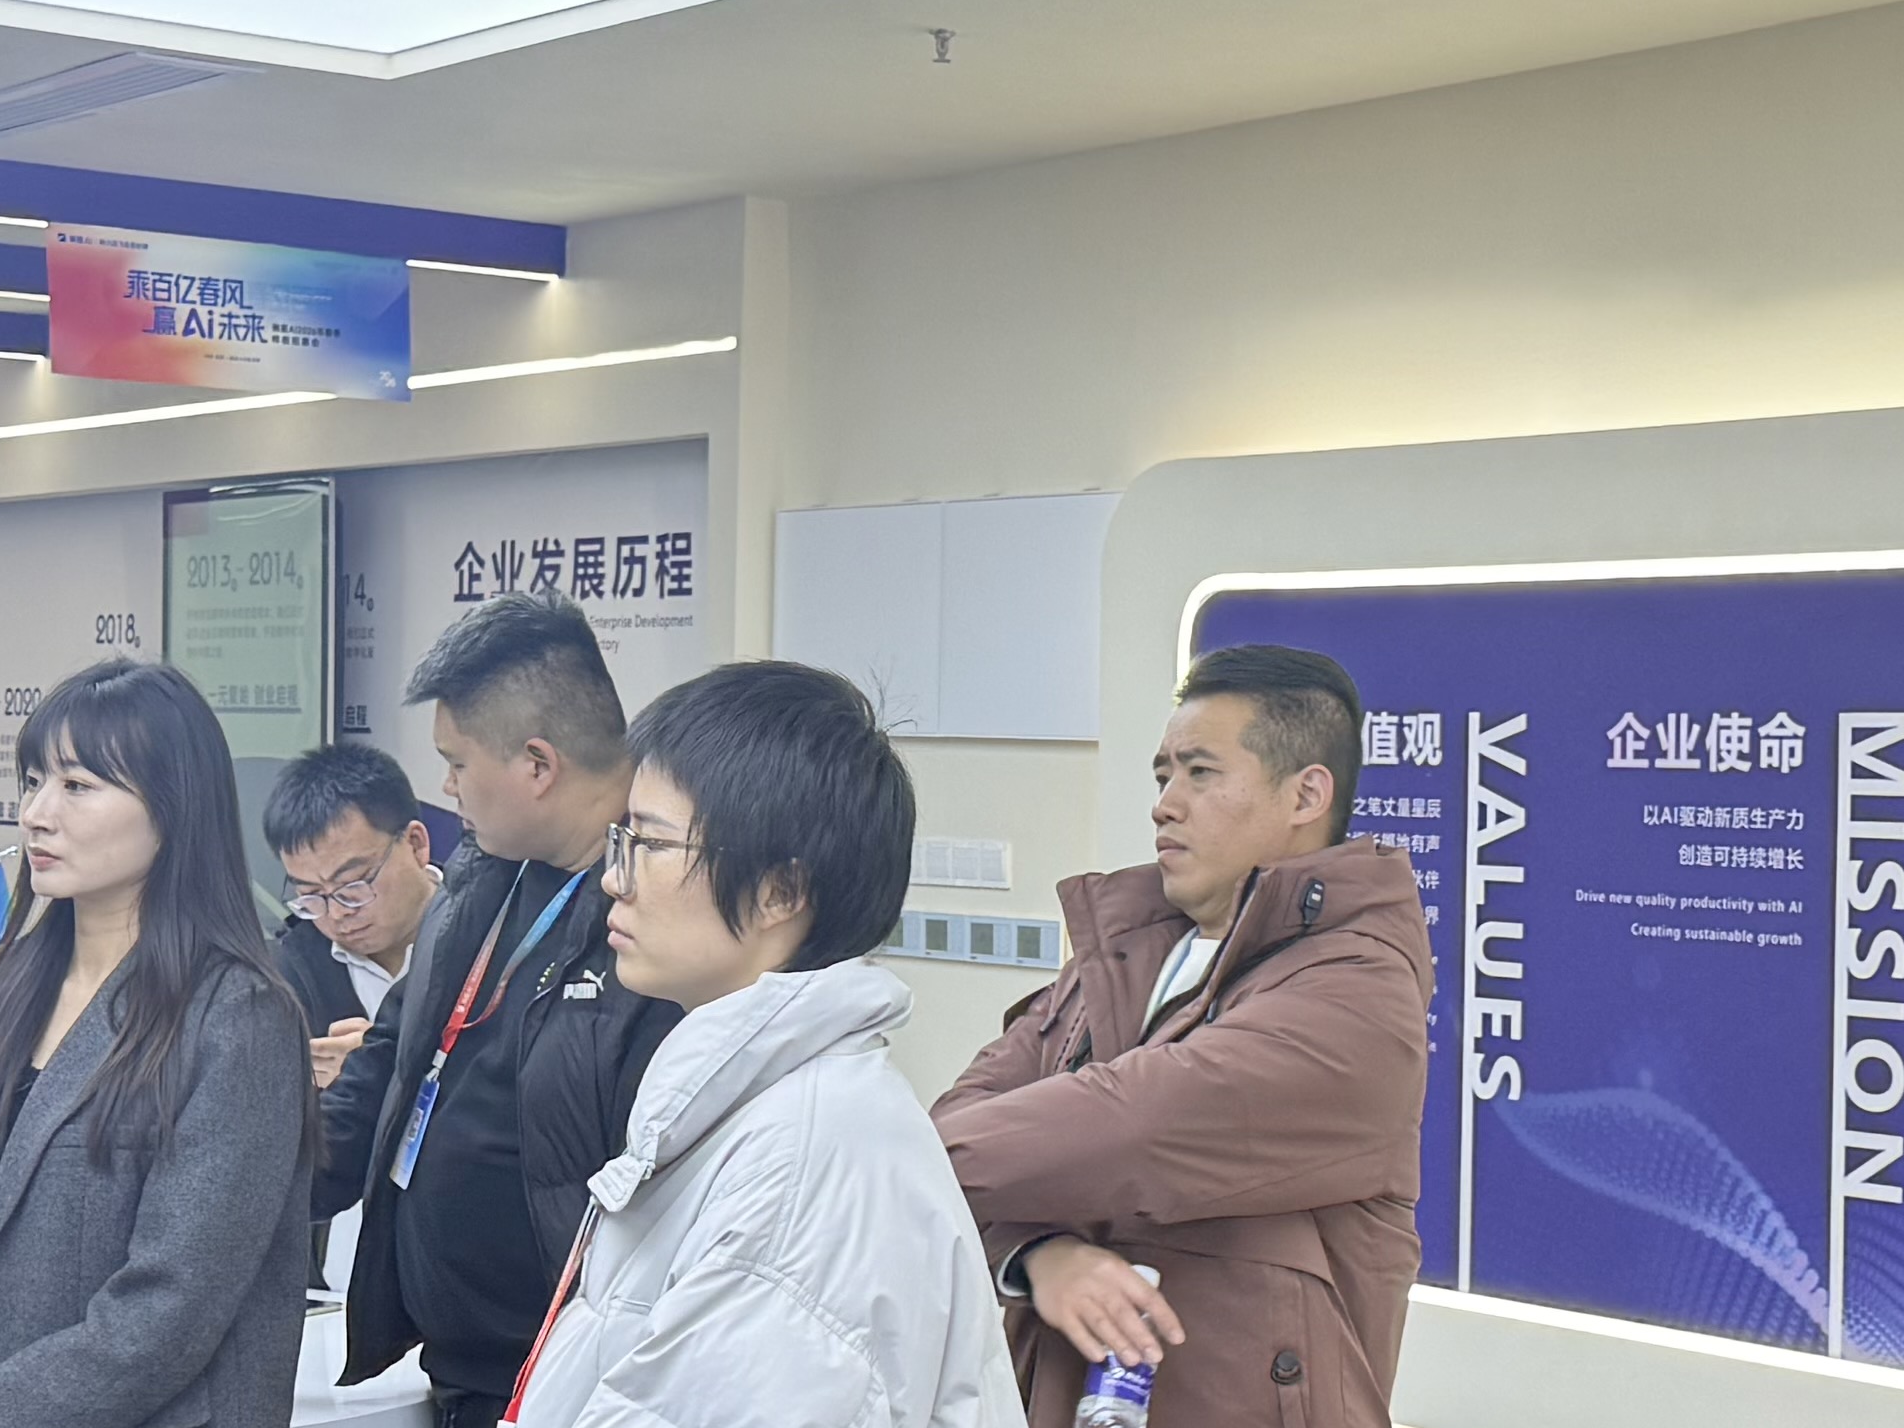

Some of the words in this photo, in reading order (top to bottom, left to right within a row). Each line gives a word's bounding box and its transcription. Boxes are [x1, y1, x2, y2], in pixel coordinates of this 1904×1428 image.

[123, 269, 253, 309] 乘百亿春风
[453, 531, 694, 603] 企业发展历程
[635, 614, 694, 630] Development
[1361, 712, 1443, 767] 值观
[1606, 711, 1807, 774] 企业使命
[1352, 797, 1442, 819] 之笔丈量星辰
[1643, 804, 1805, 831] 以AI驱动新质生产力
[1678, 843, 1805, 870] 创造可持续增长
[1471, 712, 1528, 1102] VALUES
[1575, 888, 1606, 903] Drive
[1608, 892, 1633, 904] new
[1635, 893, 1677, 910] quality
[1680, 895, 1755, 914] productivity
[1757, 899, 1786, 913] with
[1788, 900, 1804, 914] AI
[1630, 922, 1682, 942] Creating
[1684, 925, 1754, 944] sustainable
[1756, 931, 1804, 948] growth
